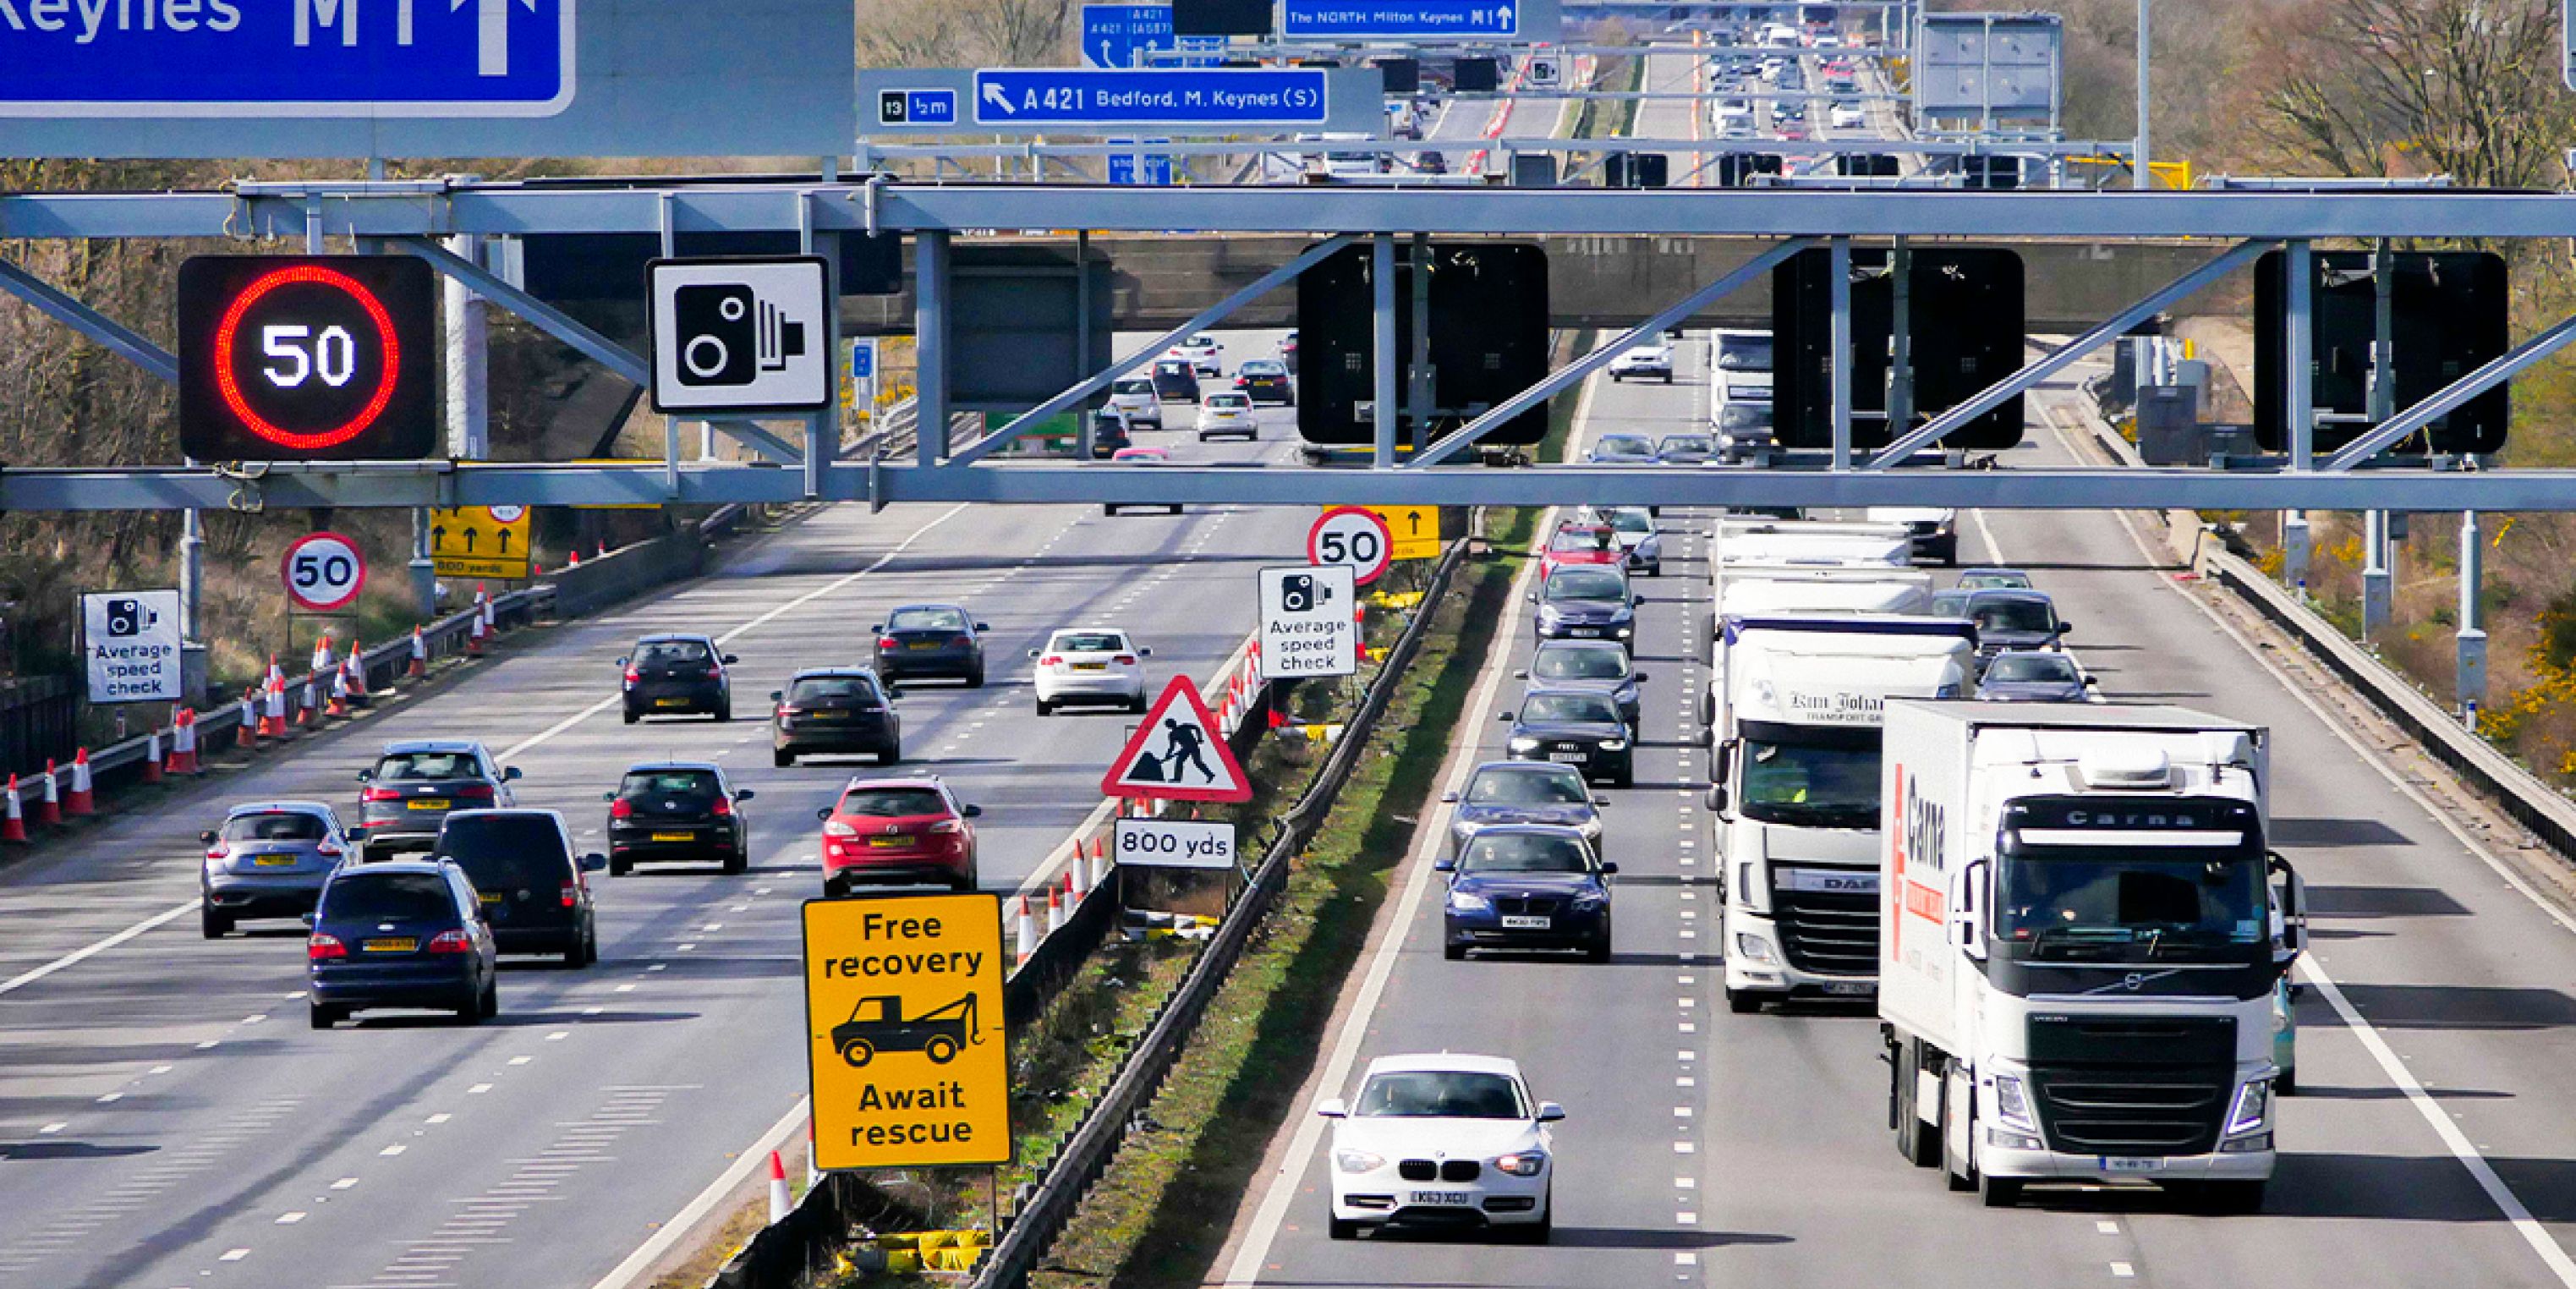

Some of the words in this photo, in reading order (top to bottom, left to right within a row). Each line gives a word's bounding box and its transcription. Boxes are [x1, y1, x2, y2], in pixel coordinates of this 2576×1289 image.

[293, 0, 414, 46] M1
[1291, 11, 1312, 23] The
[1318, 11, 1366, 24] NORTH
[1373, 11, 1415, 24] Milton
[1418, 11, 1464, 25] Keynes
[1471, 9, 1493, 25] M1
[885, 101, 902, 115] 13
[1023, 88, 1083, 110] A421
[1213, 91, 1278, 109] Keynes
[262, 325, 354, 387] 50
[1322, 530, 1378, 563] 50
[294, 554, 353, 588] 50
[1270, 619, 1347, 635] Average
[96, 644, 172, 659] Average
[1280, 636, 1335, 652] speed
[107, 661, 162, 677] speed
[1280, 655, 1336, 671] check
[107, 680, 162, 695] check
[1909, 772, 1944, 872] Carna
[2067, 810, 2195, 826] Carna
[1122, 831, 1176, 853] 800
[1186, 834, 1227, 858] yds
[863, 912, 942, 941] Free
[824, 950, 984, 978] recovery
[858, 1080, 967, 1111] Await
[851, 1121, 973, 1146] rescue
